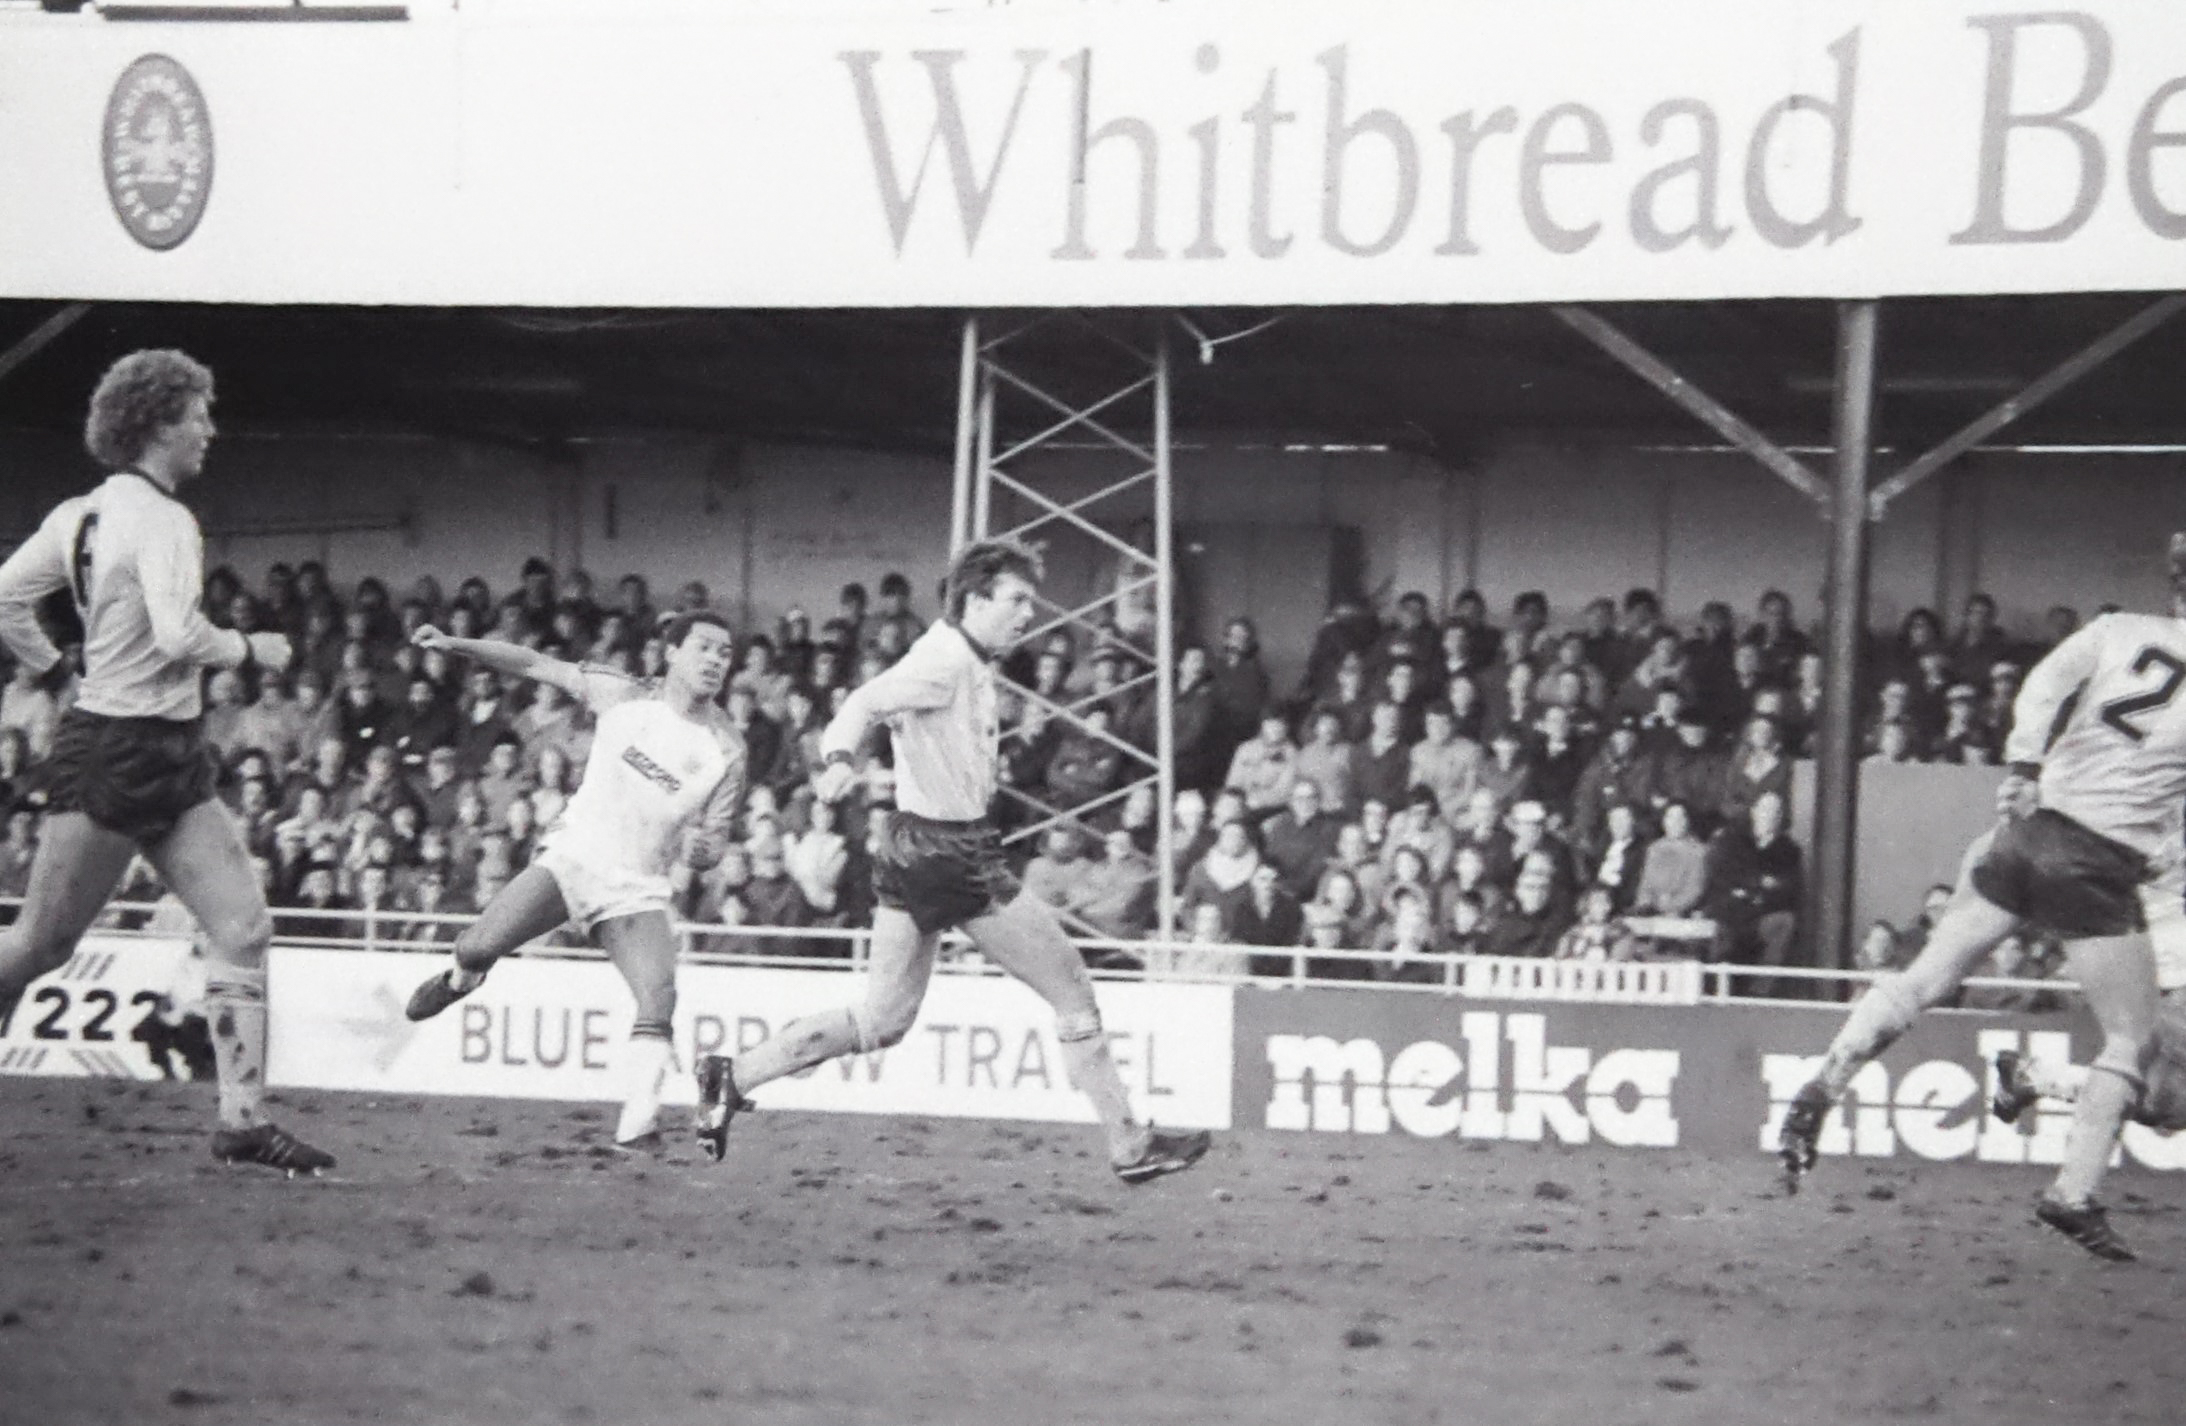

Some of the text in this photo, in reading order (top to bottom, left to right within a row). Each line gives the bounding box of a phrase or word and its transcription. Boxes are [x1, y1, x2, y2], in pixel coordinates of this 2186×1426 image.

[836, 25, 1862, 259] Whitbread
[2101, 645, 2186, 742] 2
[461, 1004, 609, 1069] BLUE
[926, 1023, 1174, 1095] TRAEL
[1266, 1011, 1680, 1147] melka
